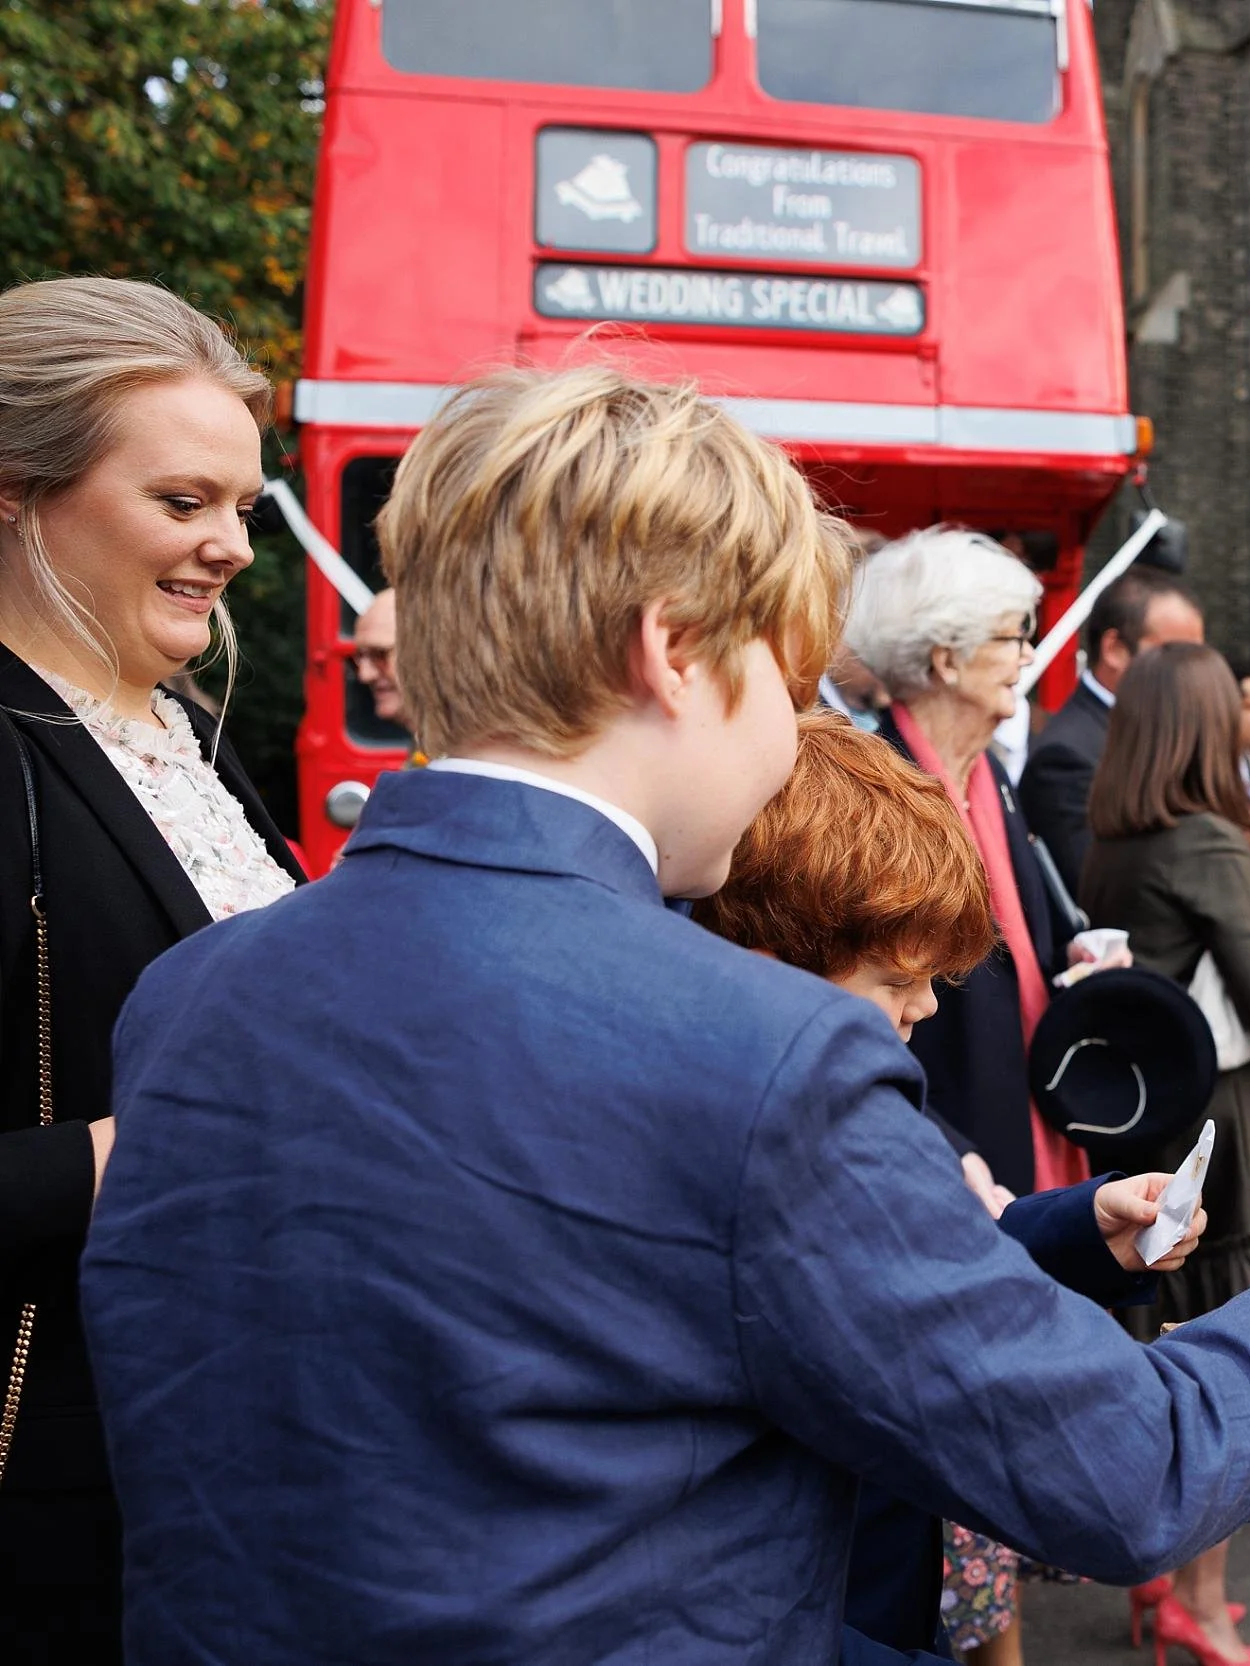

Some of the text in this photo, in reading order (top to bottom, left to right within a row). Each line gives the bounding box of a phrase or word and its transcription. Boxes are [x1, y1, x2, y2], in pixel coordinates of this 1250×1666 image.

[706, 145, 897, 188] Congratulations
[772, 184, 832, 218] From
[695, 213, 908, 258] Traditional Travel
[600, 271, 877, 325] WEDDING SPECIAL
